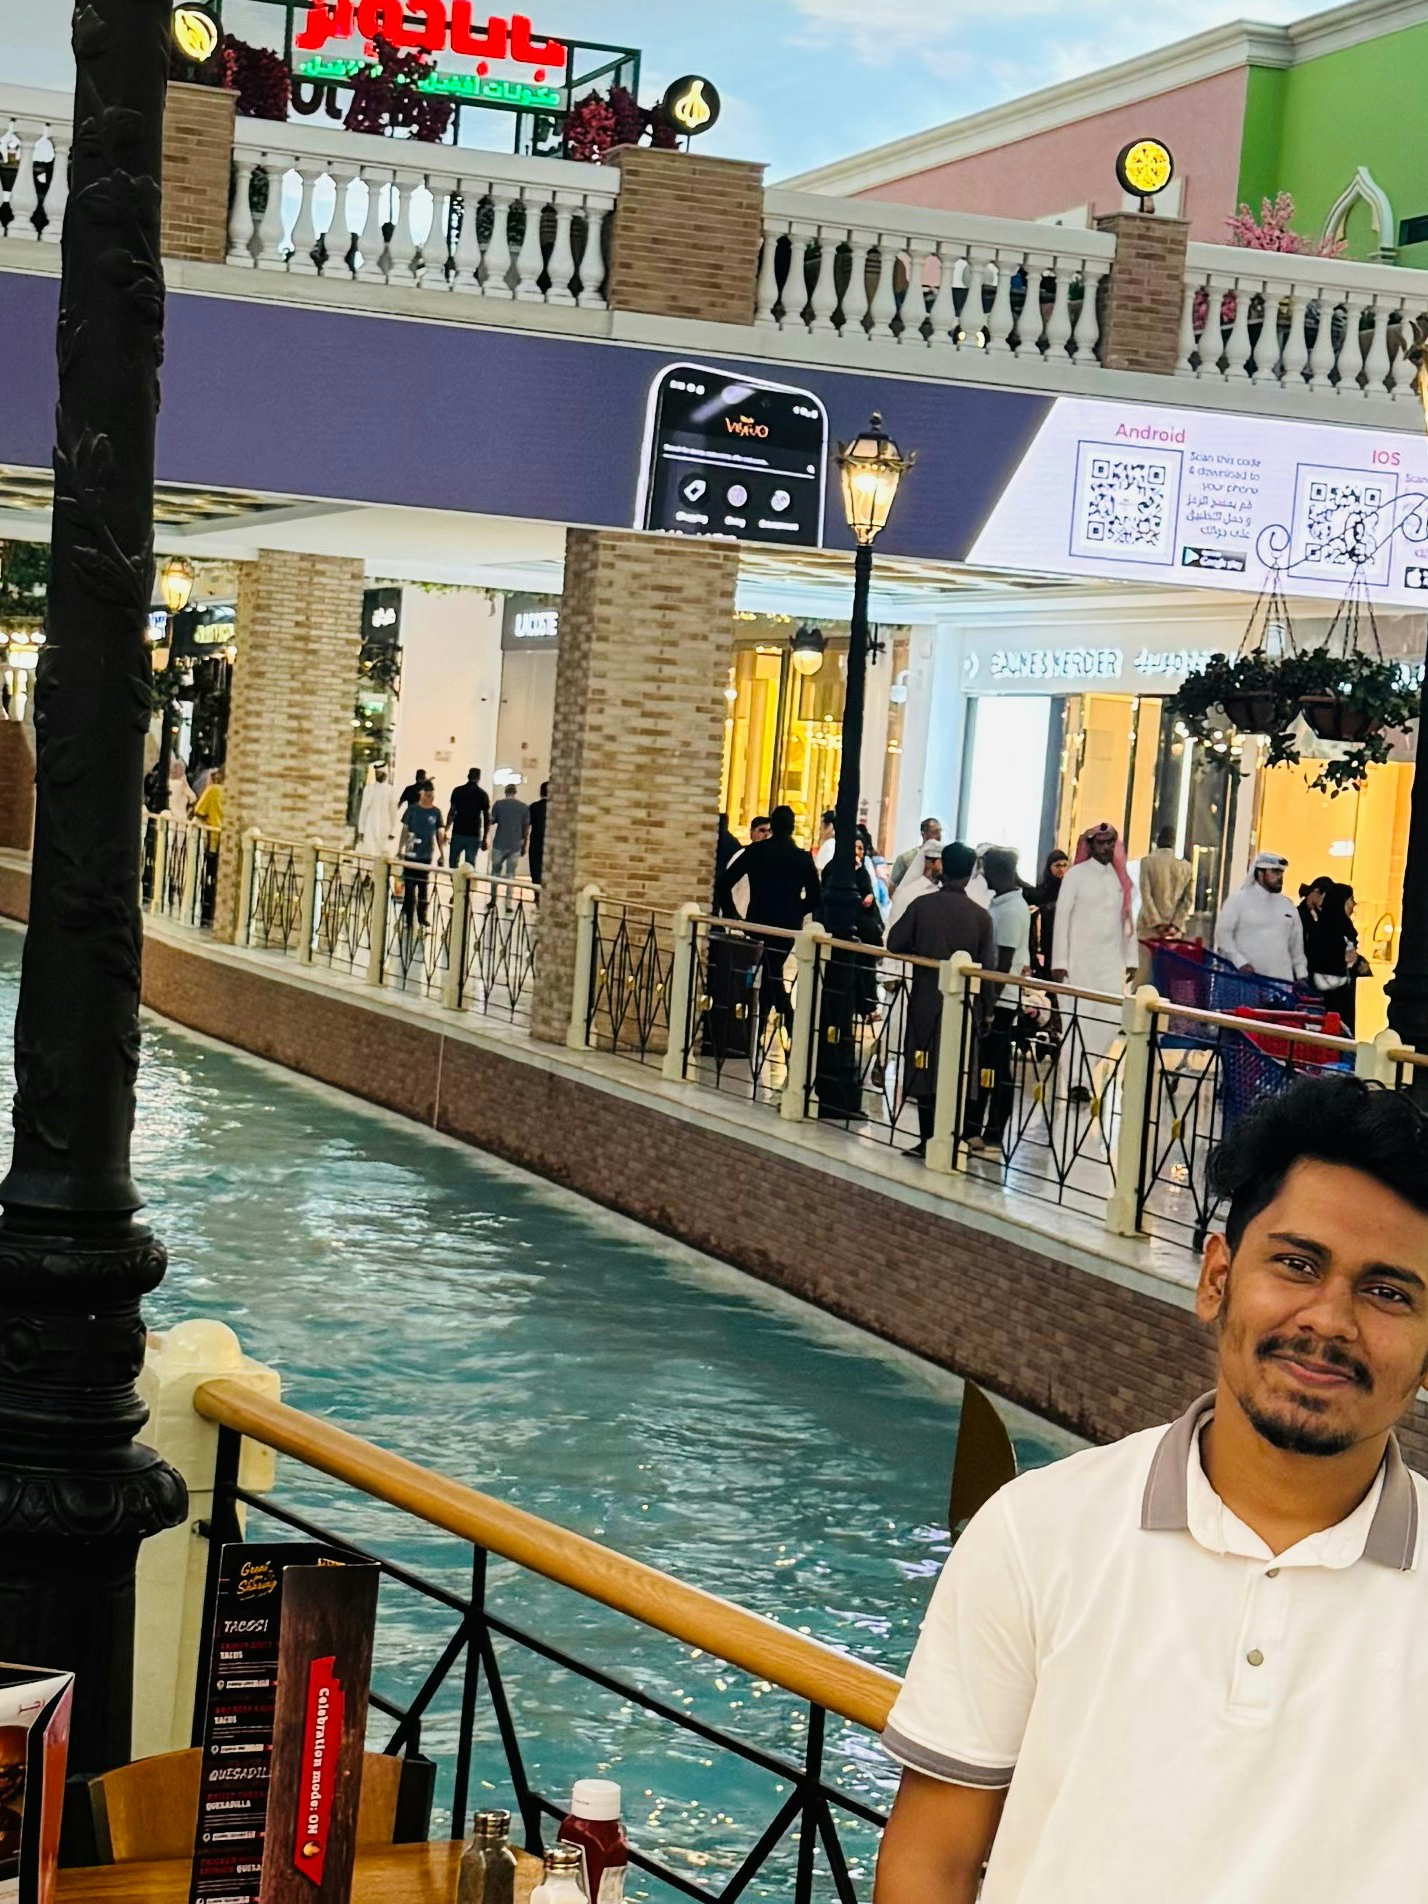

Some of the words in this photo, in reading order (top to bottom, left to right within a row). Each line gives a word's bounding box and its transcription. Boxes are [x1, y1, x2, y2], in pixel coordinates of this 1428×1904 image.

[1115, 423, 1186, 444] Android
[1189, 450, 1214, 464] Scan
[313, 1687, 330, 1768] Celebration
[209, 1767, 272, 1782] QUESADIL
[309, 1770, 322, 1812] mode:
[307, 1814, 320, 1836] ON
[236, 1863, 262, 1874] QUESA
